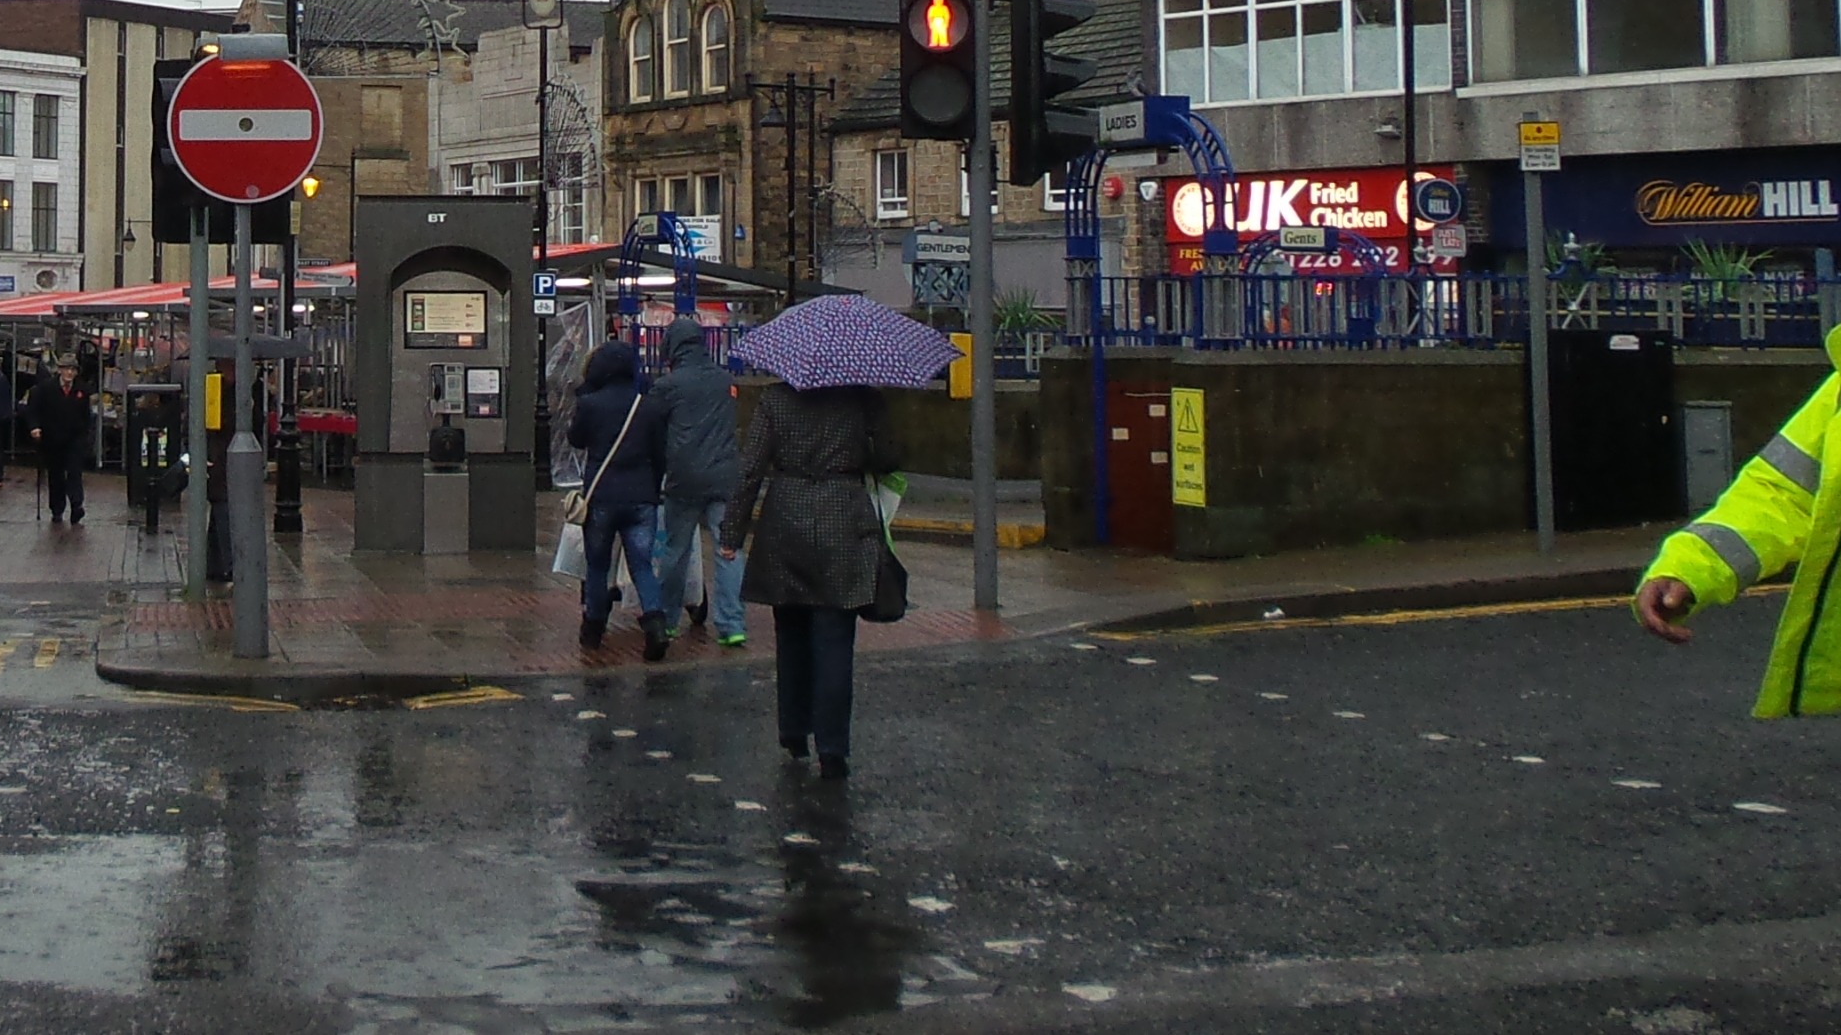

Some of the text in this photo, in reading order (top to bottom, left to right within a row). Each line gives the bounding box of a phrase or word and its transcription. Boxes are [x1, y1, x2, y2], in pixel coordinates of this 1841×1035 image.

[1105, 114, 1137, 132] LADIES
[1310, 182, 1359, 205] Fried
[1636, 179, 1840, 222] William HILL
[1428, 198, 1451, 214] HILL
[427, 213, 448, 223] BT
[1310, 206, 1388, 229] Chicken
[1284, 231, 1317, 244] Gents
[539, 276, 552, 293] P
